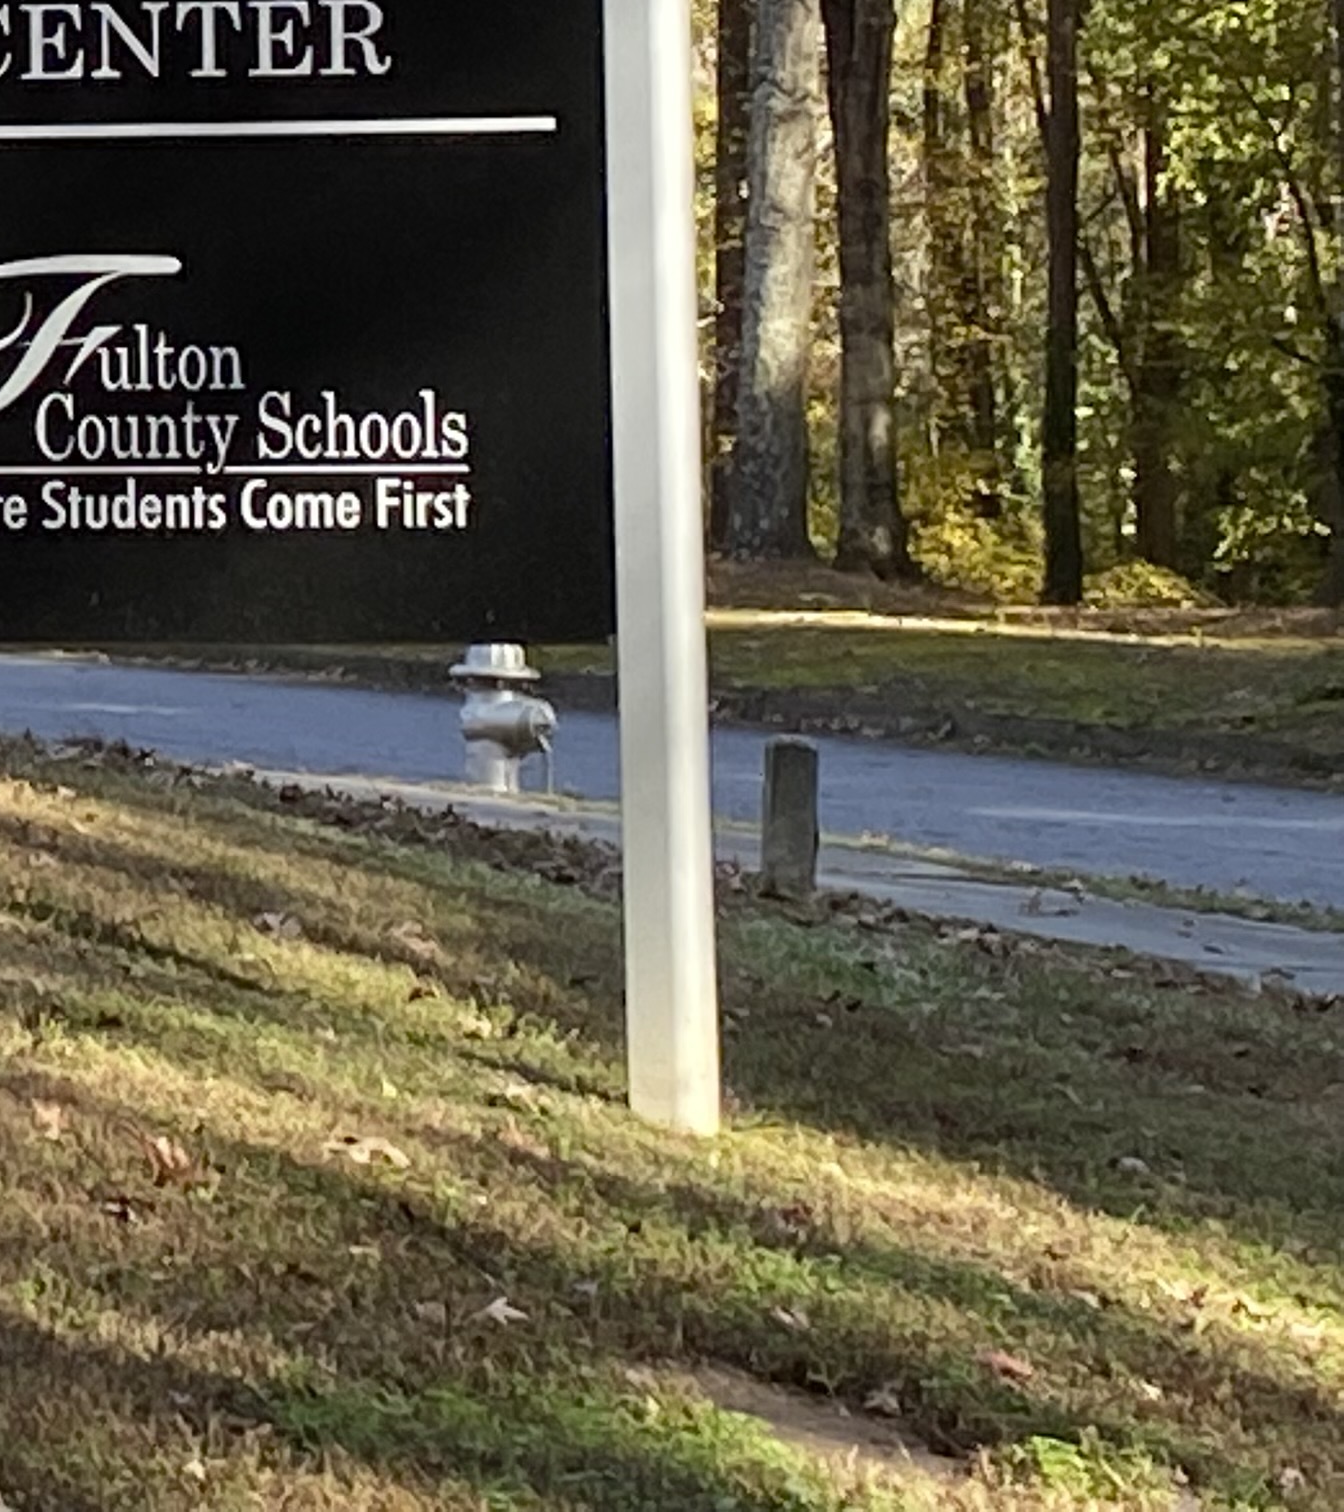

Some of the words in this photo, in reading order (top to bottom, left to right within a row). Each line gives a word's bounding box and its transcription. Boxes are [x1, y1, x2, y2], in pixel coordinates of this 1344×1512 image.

[34, 391, 242, 475] County
[256, 388, 470, 460] Schools
[40, 476, 228, 530] Students
[239, 478, 362, 530] Come
[374, 477, 473, 530] First
